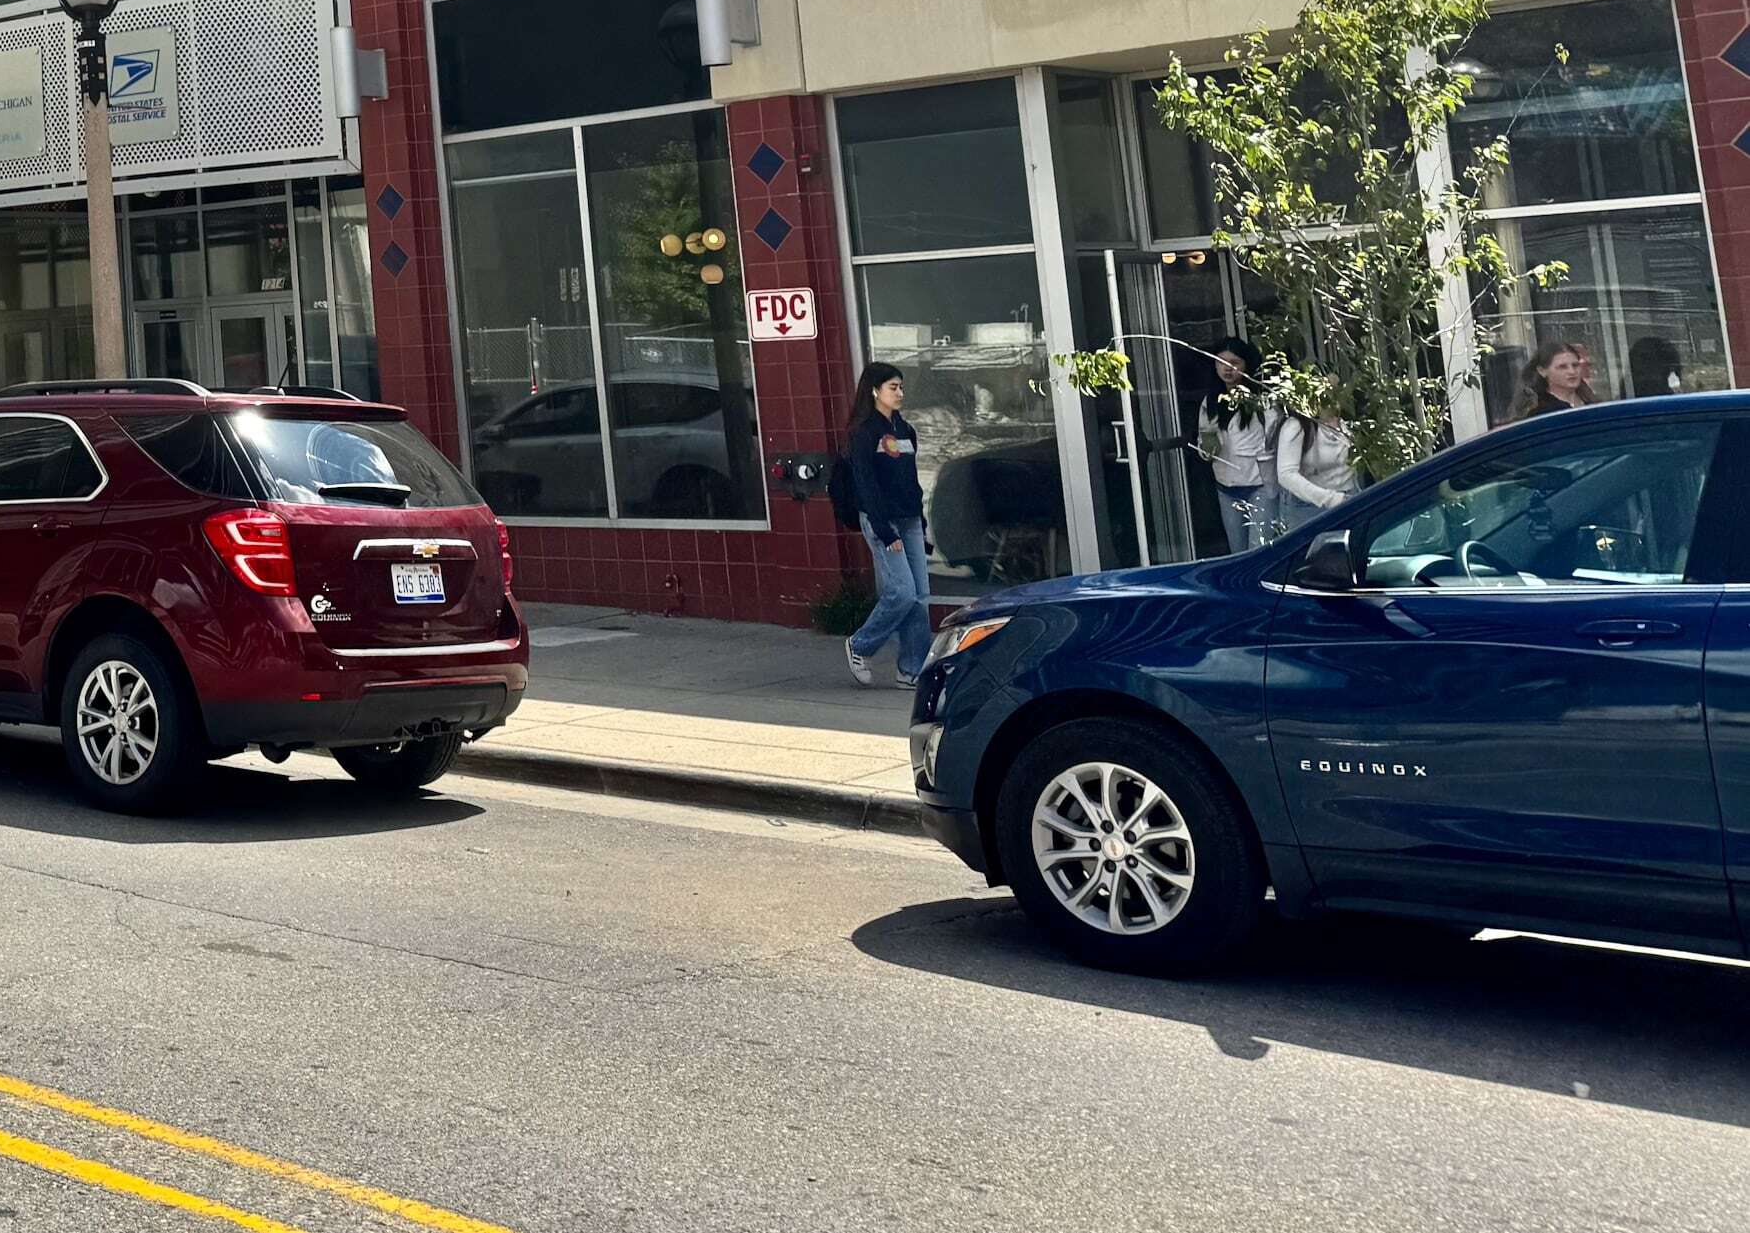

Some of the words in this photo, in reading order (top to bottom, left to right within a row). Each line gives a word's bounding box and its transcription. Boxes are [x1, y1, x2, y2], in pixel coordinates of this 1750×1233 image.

[132, 109, 166, 122] SERVICE
[755, 293, 807, 322] FDC
[1300, 760, 1427, 777] EQUINOX
